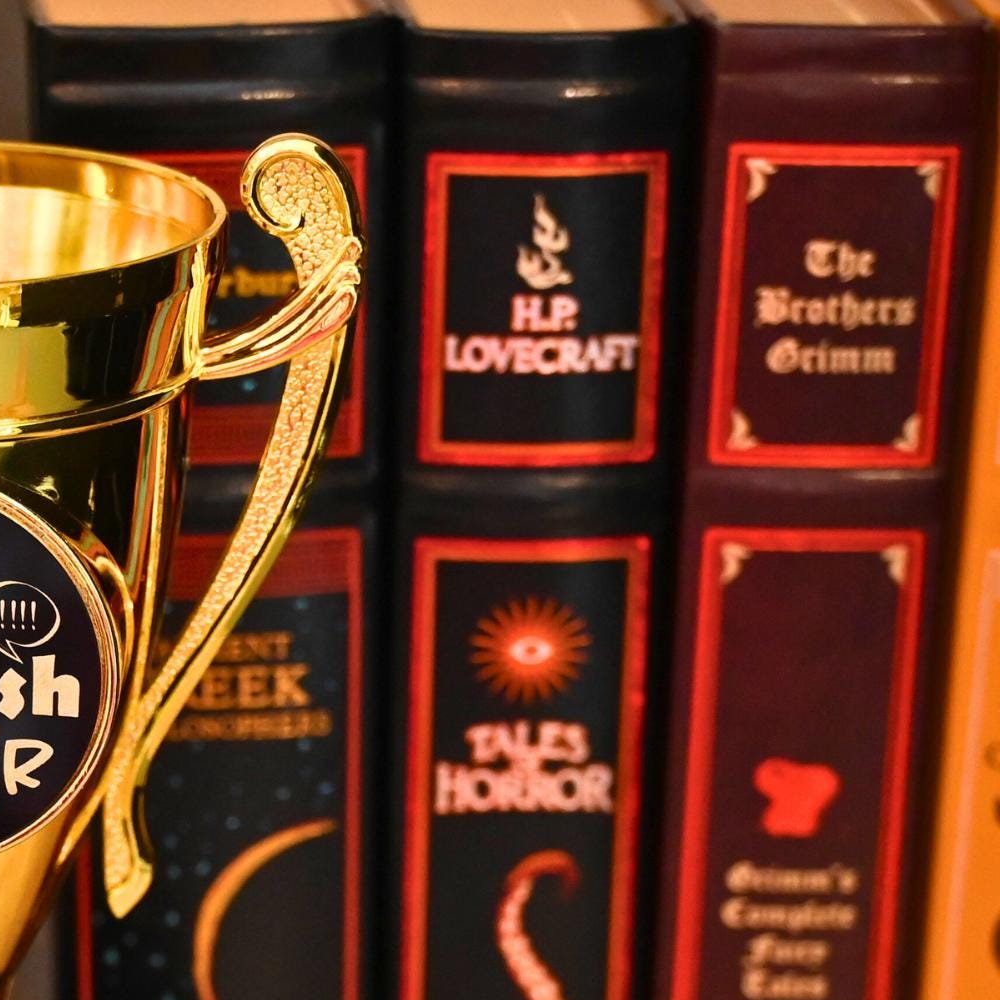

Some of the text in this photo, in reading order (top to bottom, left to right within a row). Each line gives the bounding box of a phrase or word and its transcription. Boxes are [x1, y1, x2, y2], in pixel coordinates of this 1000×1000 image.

[804, 239, 874, 282] The
[755, 285, 916, 330] Brothers
[445, 335, 638, 375] LOVECRAFT
[765, 337, 896, 374] Grimm
[467, 720, 589, 764] TALES
[435, 762, 613, 814] HORROR
